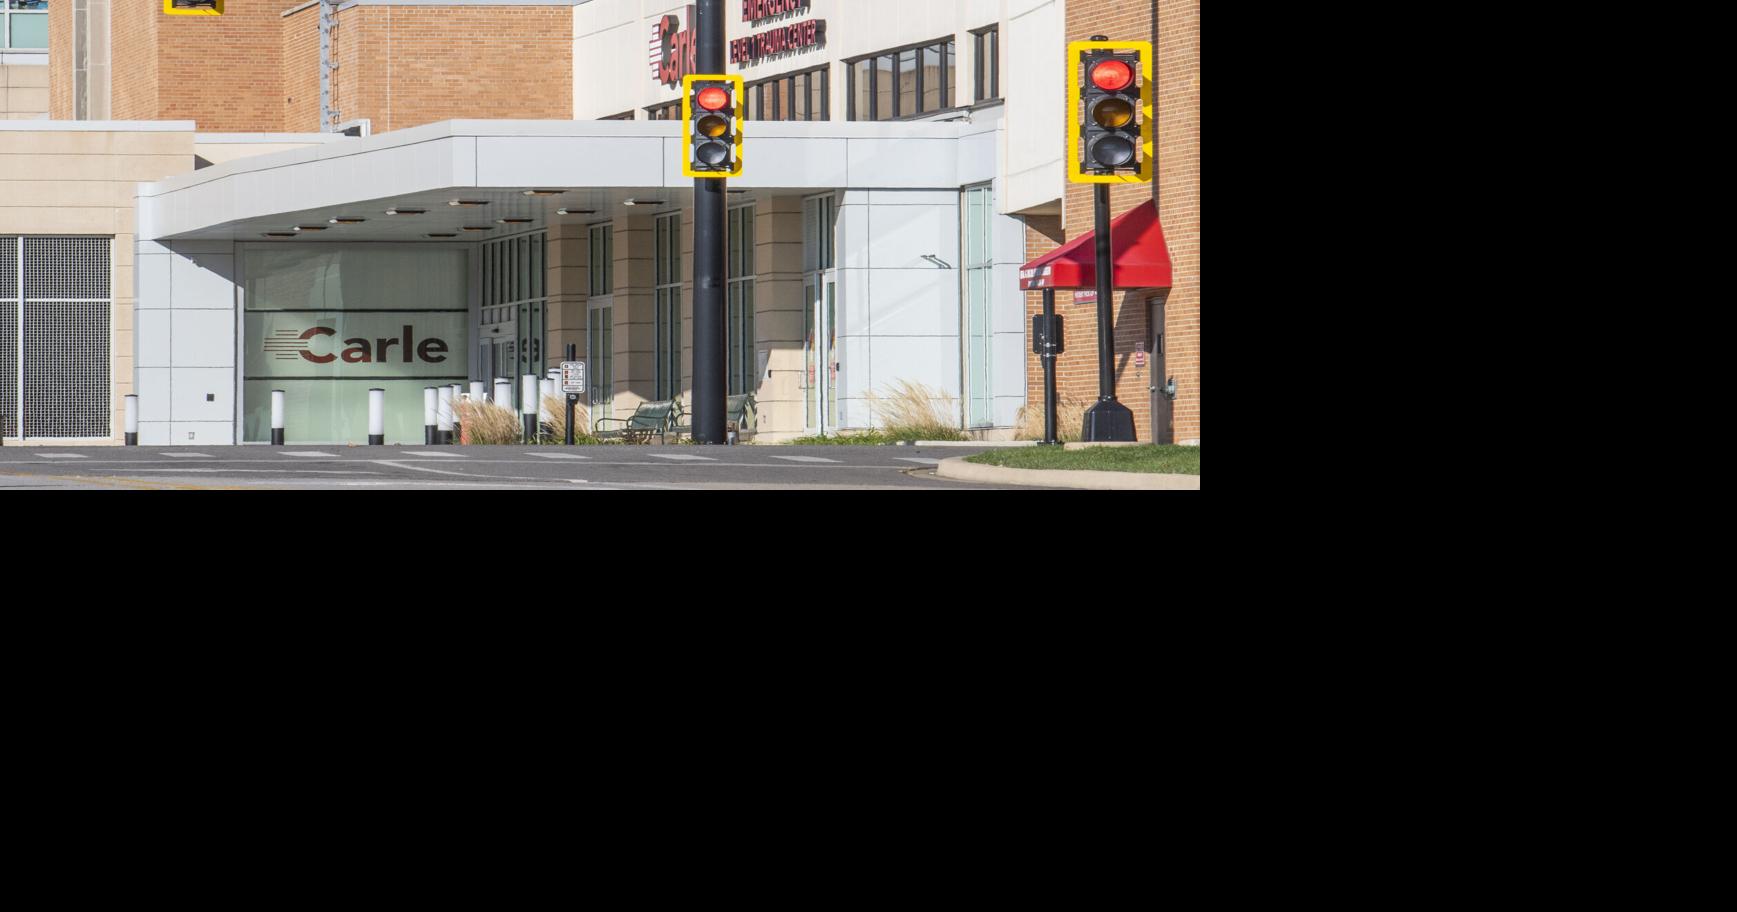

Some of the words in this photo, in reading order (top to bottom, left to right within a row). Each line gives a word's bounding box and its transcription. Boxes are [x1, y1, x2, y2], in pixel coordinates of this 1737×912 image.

[742, 0, 801, 22] EMERG
[756, 27, 786, 58] TRAUMA
[787, 19, 817, 49] CENTER
[299, 325, 449, 363] Carle
